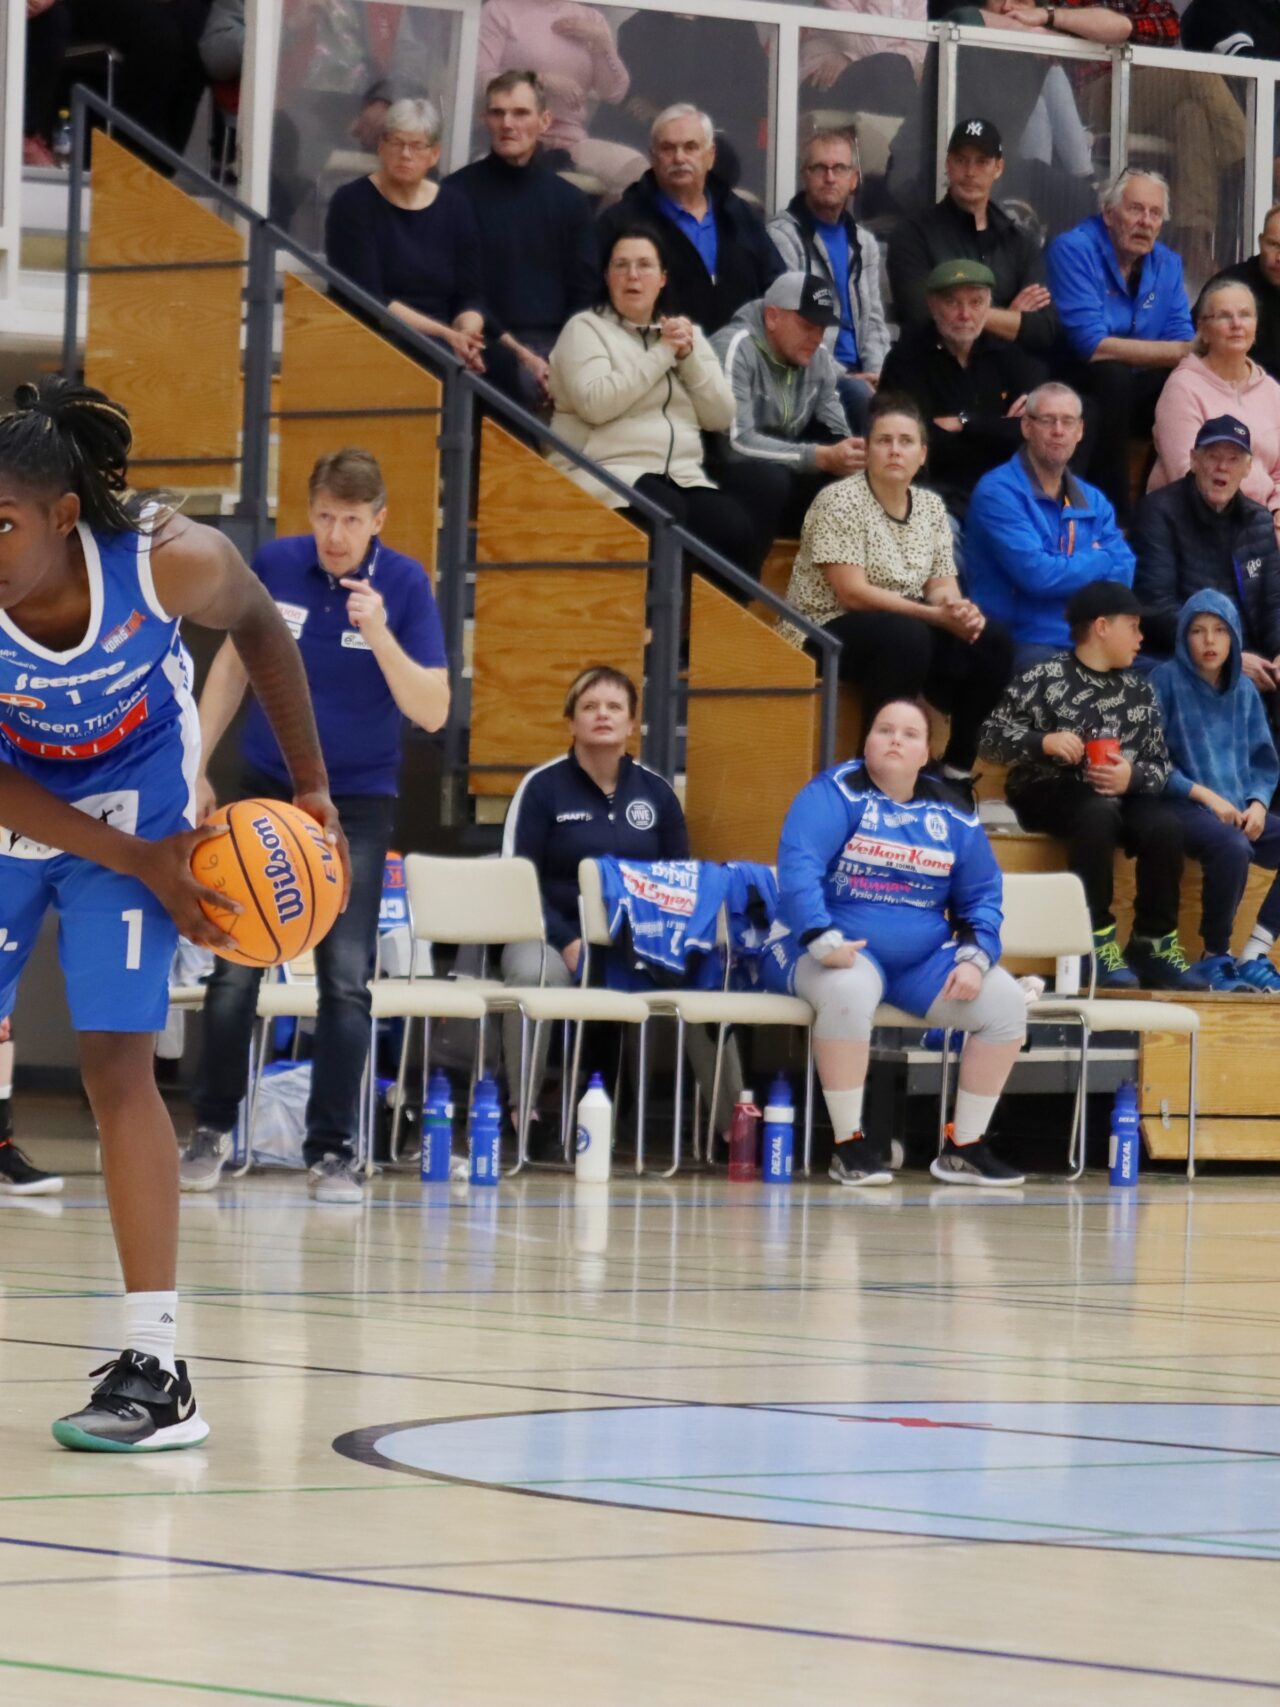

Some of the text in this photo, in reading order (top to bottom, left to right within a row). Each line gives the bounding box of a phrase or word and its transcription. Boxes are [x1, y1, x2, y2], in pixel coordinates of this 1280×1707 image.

[65, 689, 82, 705] 1
[18, 711, 79, 733] Green
[631, 809, 650, 821] VIVE
[252, 816, 304, 924] Wilson
[122, 909, 143, 970] 1
[422, 1133, 432, 1174] DEXAL
[771, 1136, 782, 1176] DEXAL
[1121, 1141, 1132, 1179] DEXAL
